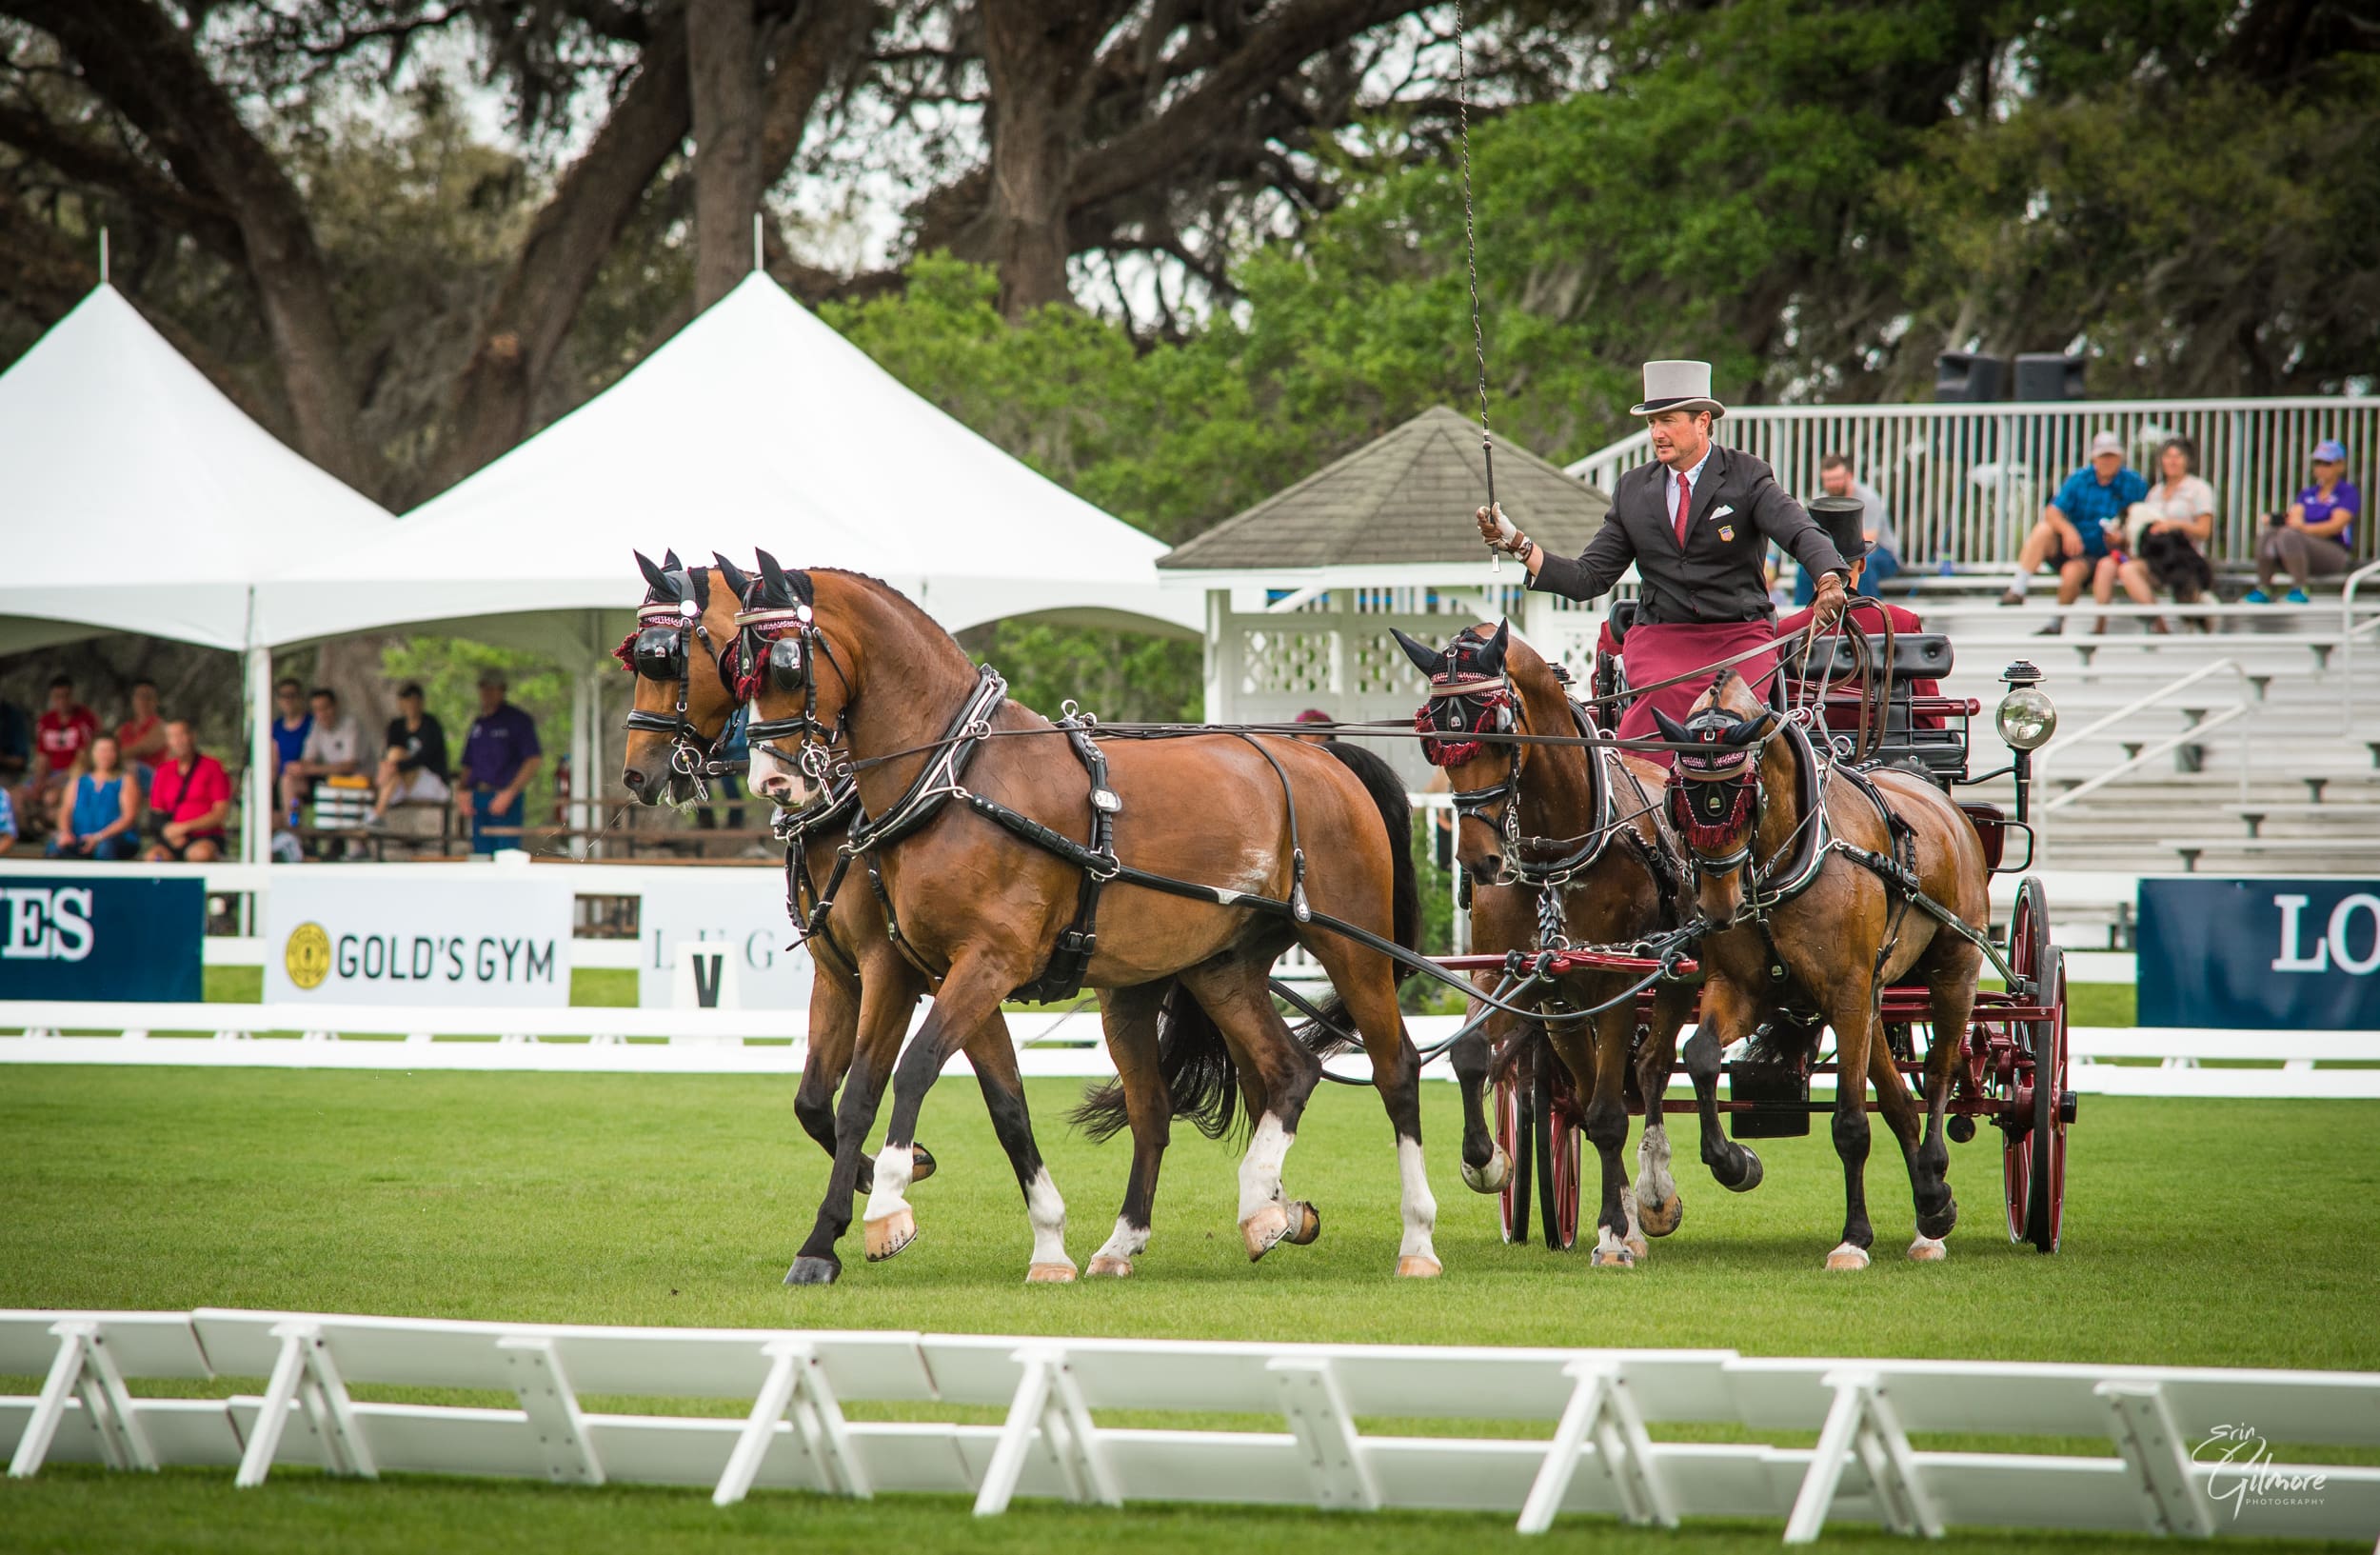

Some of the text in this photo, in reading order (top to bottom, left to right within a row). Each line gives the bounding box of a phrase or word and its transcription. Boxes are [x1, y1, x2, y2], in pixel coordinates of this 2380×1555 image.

[0, 887, 94, 962] ES
[653, 928, 812, 970] LG
[2271, 893, 2380, 975] LO
[337, 933, 465, 981] GOLD'S
[476, 937, 555, 983] GYM
[692, 954, 724, 1008] V
